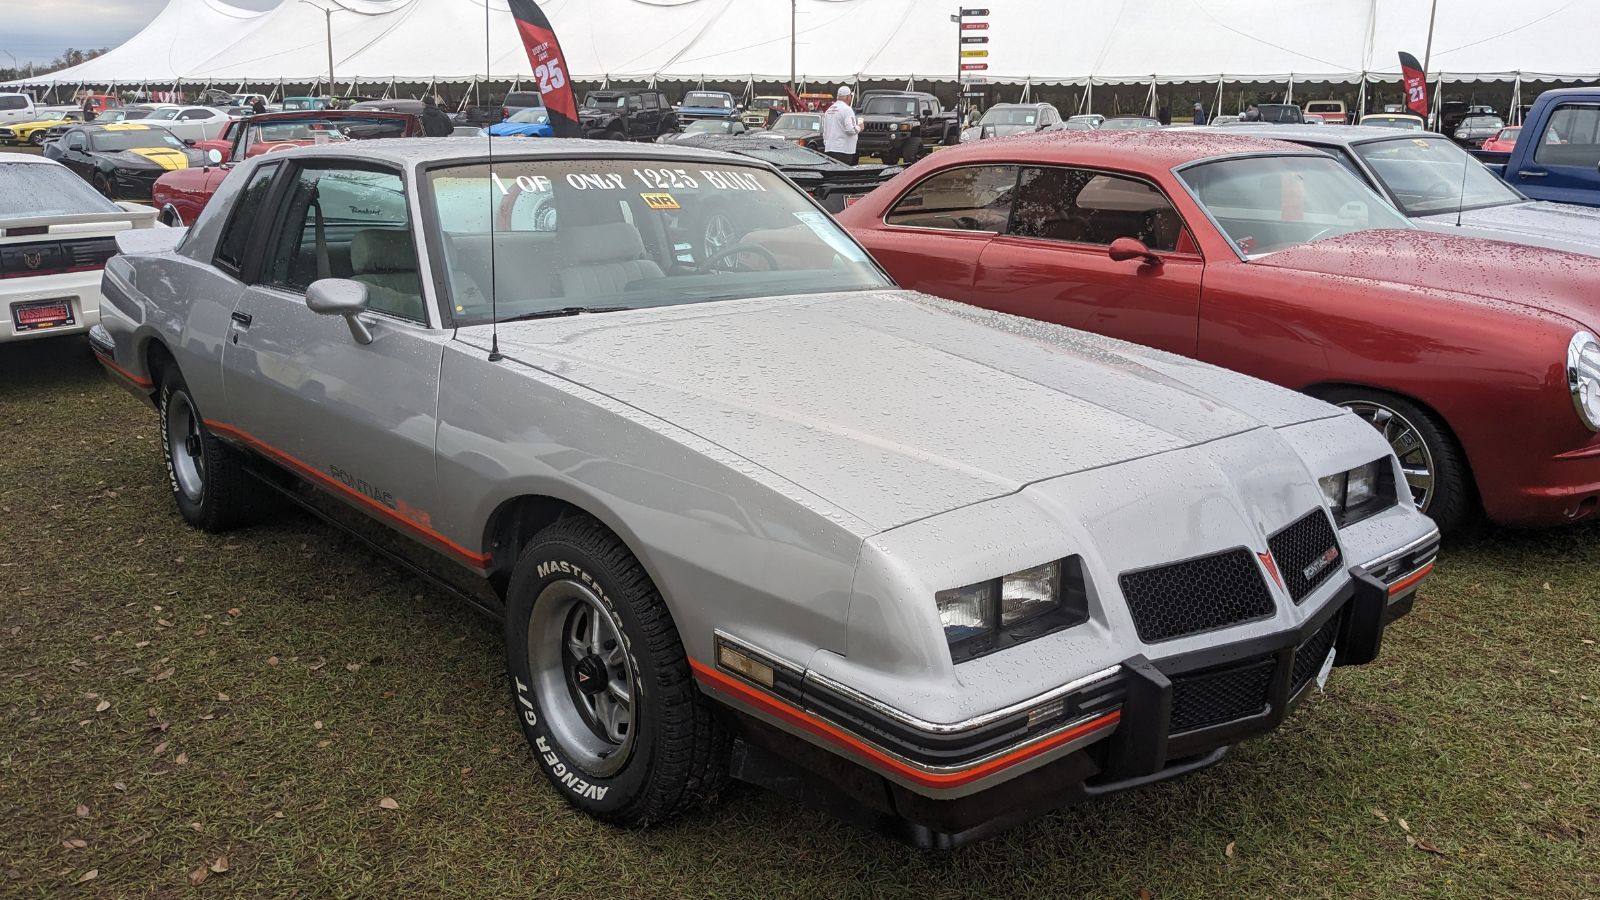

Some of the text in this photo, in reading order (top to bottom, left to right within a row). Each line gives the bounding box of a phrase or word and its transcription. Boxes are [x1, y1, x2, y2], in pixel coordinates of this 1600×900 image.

[535, 58, 565, 94] 25
[1409, 86, 1424, 102] 21
[491, 168, 767, 195] 1 OF ONLY 1225 BUILT
[645, 196, 676, 206] NR
[330, 464, 396, 510] PONTIAC
[514, 676, 609, 801] AVENGER G/T
